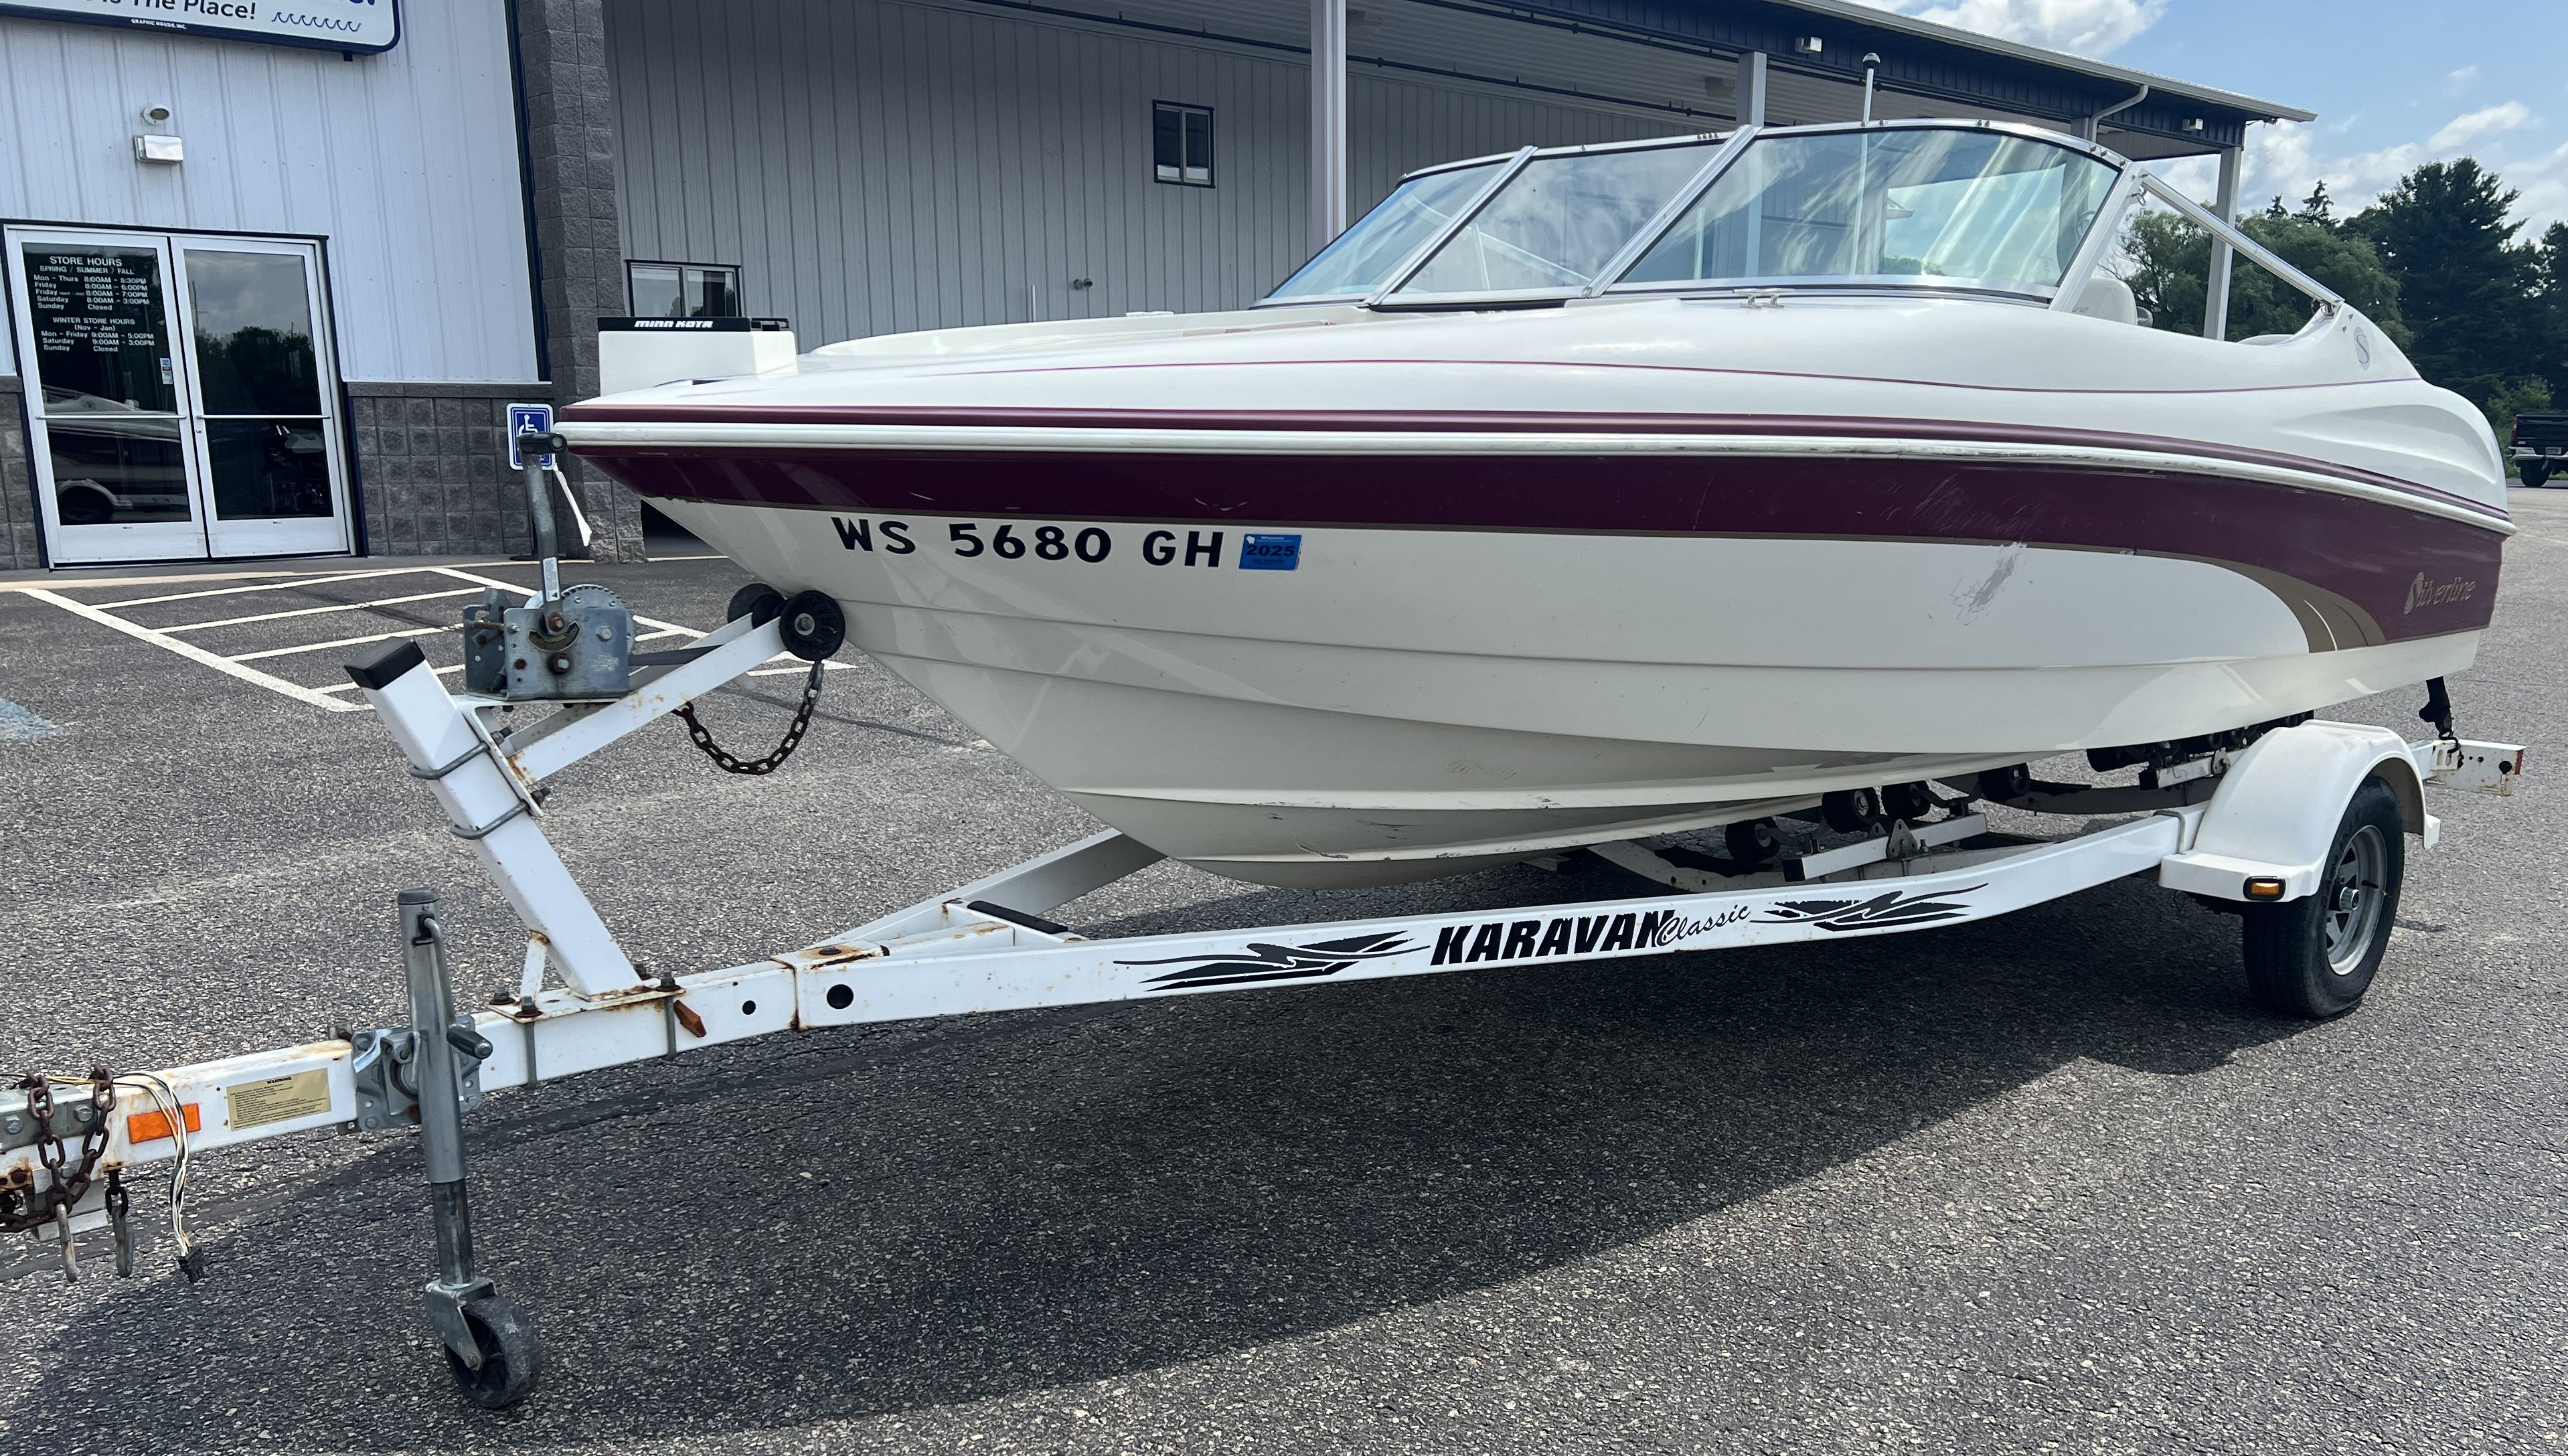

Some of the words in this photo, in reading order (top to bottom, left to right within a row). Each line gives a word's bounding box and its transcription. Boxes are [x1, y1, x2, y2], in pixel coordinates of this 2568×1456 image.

[183, 0, 256, 19] Place!
[50, 256, 84, 265] STORE
[87, 257, 123, 266] HOURS
[34, 281, 57, 289] Friday
[35, 288, 58, 296] Friday
[37, 295, 69, 303] Saturday
[37, 302, 65, 310] Sunday
[66, 330, 88, 338] Friday
[42, 337, 74, 345] Saturday
[830, 517, 916, 554] WS
[949, 523, 1112, 564] 5680
[1142, 530, 1224, 568] GH
[1245, 544, 1295, 556] 2025
[2403, 572, 2476, 615] Silverline
[1430, 909, 1675, 966] KARAVAN
[1656, 904, 1751, 947] Classic
